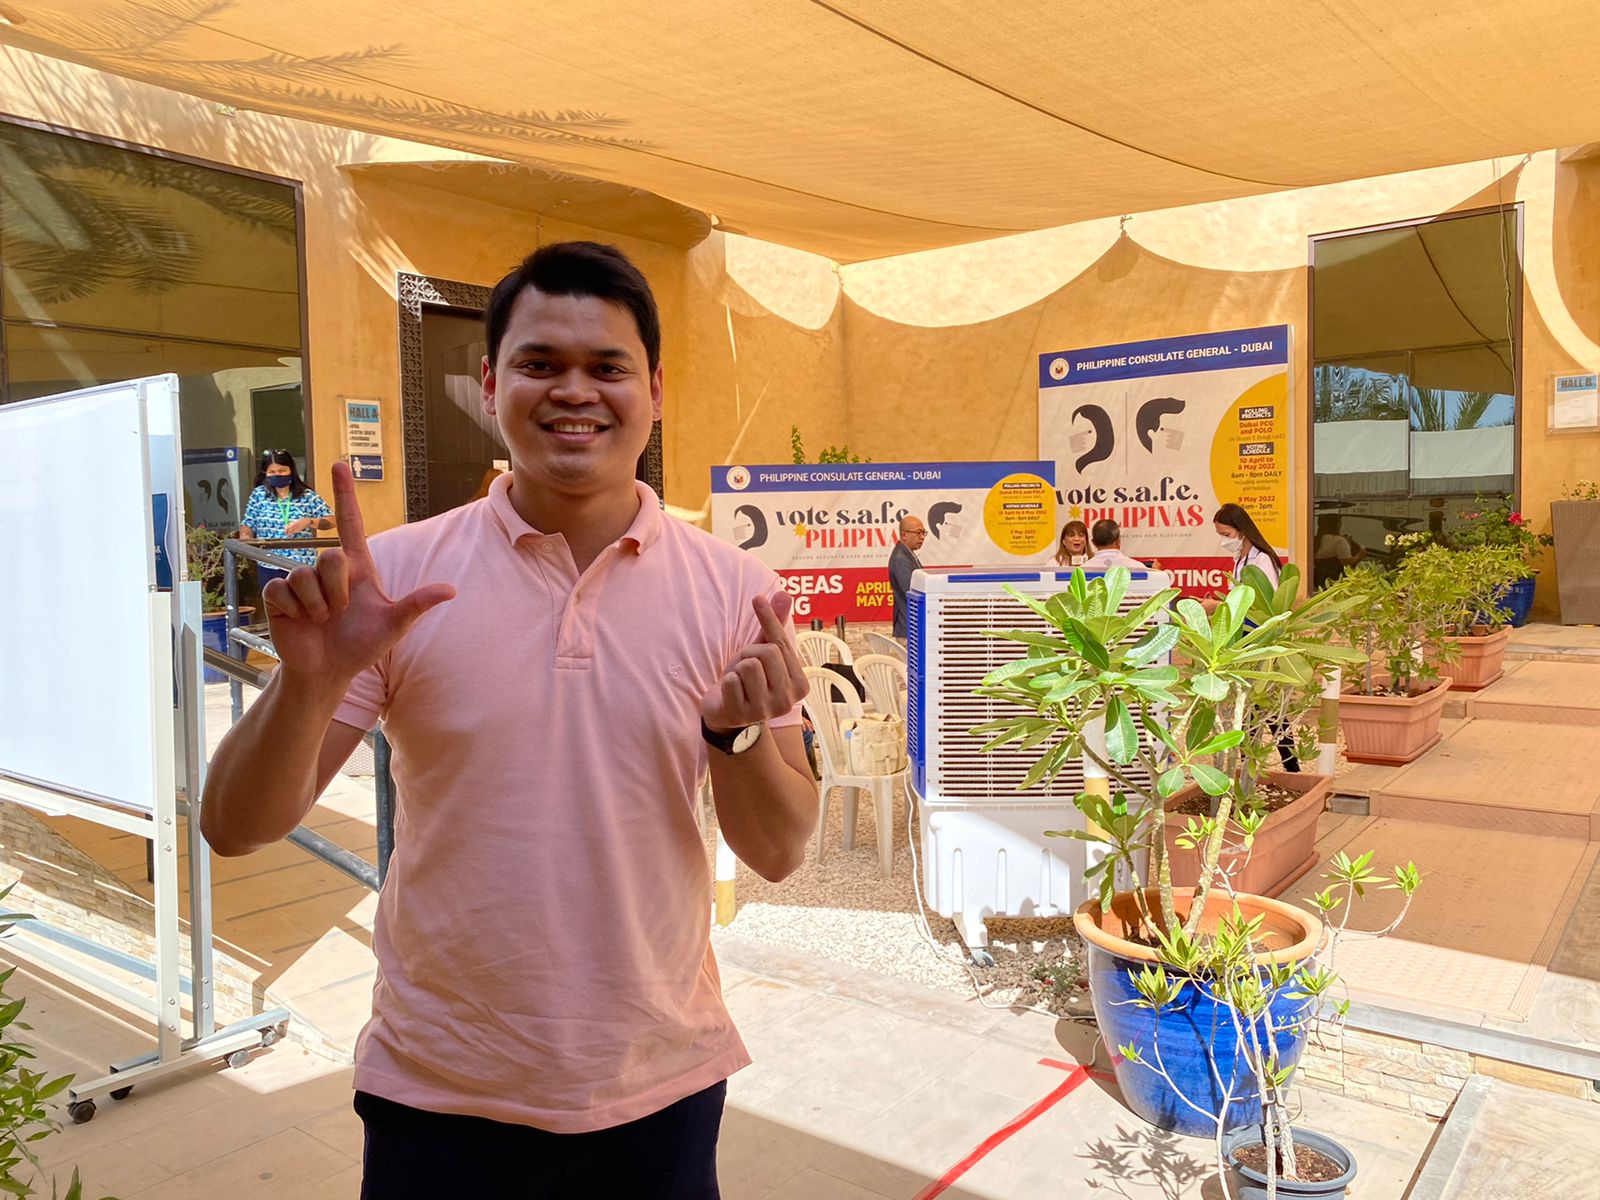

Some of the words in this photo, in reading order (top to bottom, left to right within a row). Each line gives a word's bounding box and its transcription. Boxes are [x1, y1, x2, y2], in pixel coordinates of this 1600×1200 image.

[1076, 357, 1126, 371] PHILIPPINE
[1128, 350, 1184, 364] CONSULATE
[1186, 346, 1231, 358] GENERAL
[1241, 341, 1273, 353] DUBAI
[1562, 379, 1584, 388] HALL
[349, 407, 370, 418] HALL
[760, 473, 808, 482] PHILIPPINE
[810, 472, 863, 482] CONSULATE
[865, 471, 906, 480] GENERAL
[913, 471, 941, 480] DUBAI
[1056, 485, 1107, 505] vote
[1114, 476, 1198, 504] s.a.f.e.
[776, 506, 830, 526] vote
[1083, 504, 1204, 528] PILIPINAS
[805, 528, 899, 549] PILIPINA
[779, 574, 843, 595] RSEAS
[856, 582, 893, 594] APRIL
[1167, 569, 1223, 588] OTING
[856, 595, 884, 607] MAY
